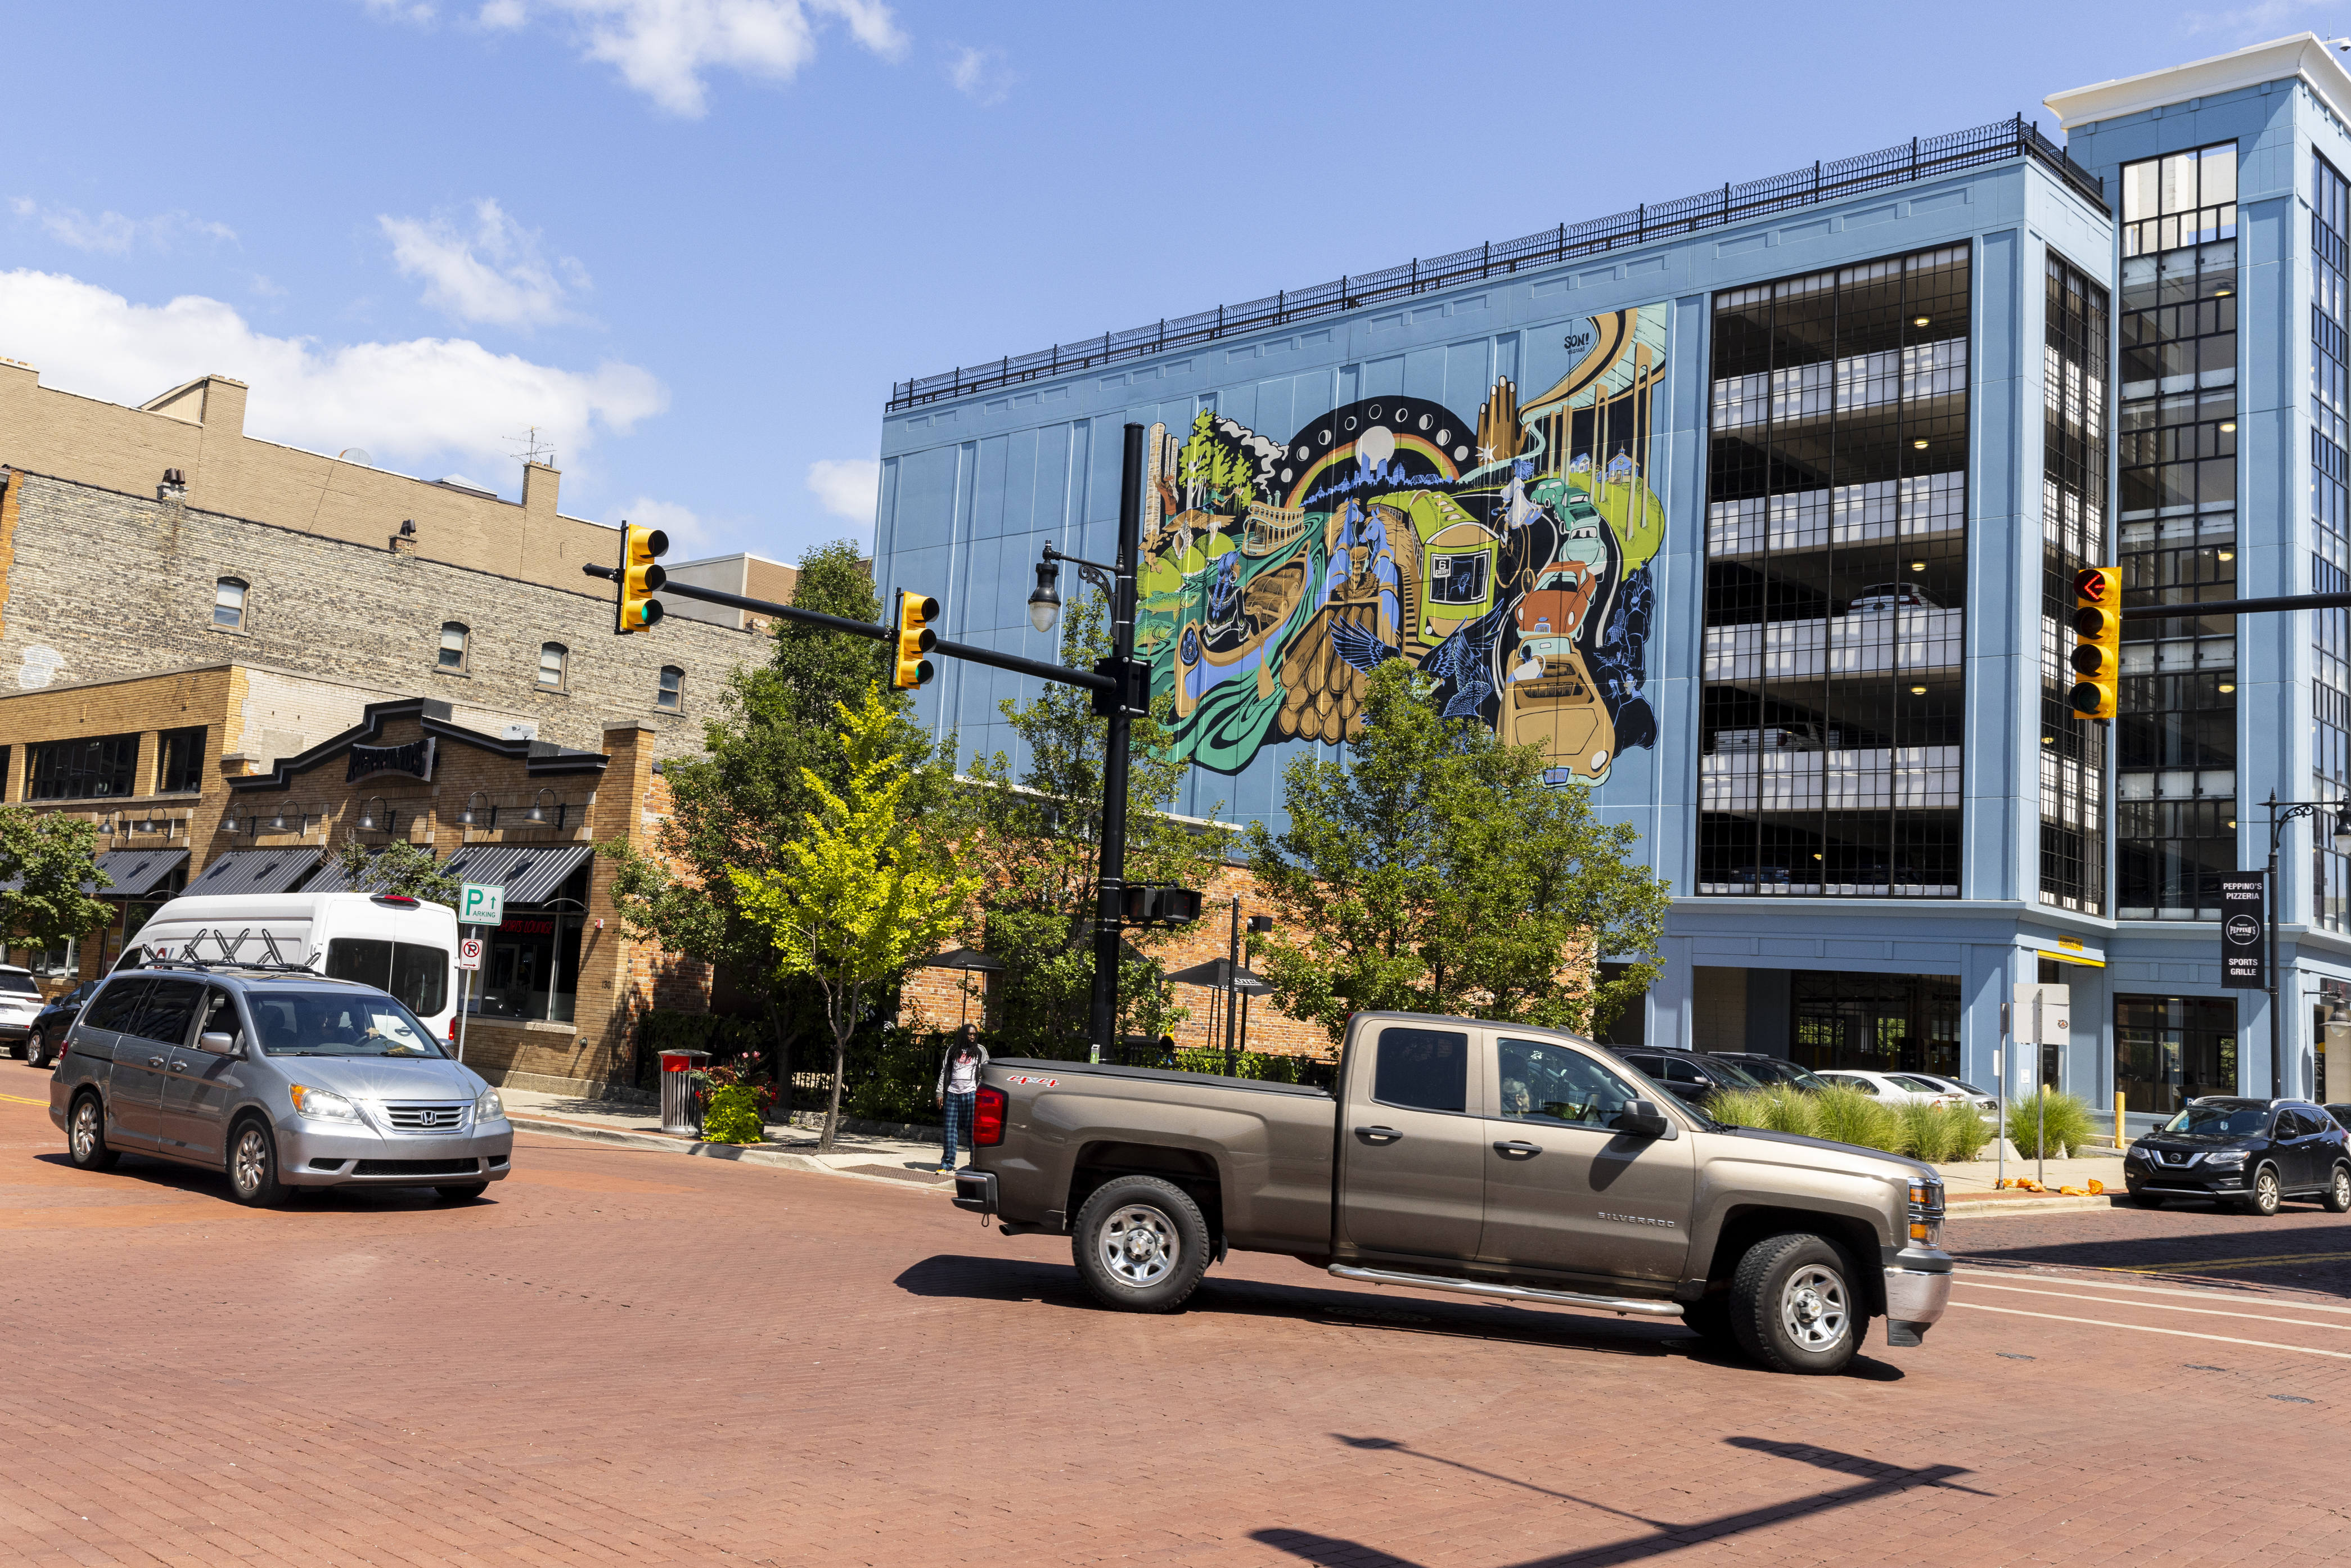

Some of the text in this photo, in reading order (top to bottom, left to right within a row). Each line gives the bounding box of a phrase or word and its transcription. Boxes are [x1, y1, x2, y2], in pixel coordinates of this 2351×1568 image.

[1564, 332, 1589, 349] SON!
[1439, 560, 1446, 569] 6
[524, 920, 553, 934] LOUNGE
[2230, 926, 2255, 935] PEPPINO'S
[602, 980, 611, 989] 130
[1597, 1212, 1674, 1228] SILVERADO
